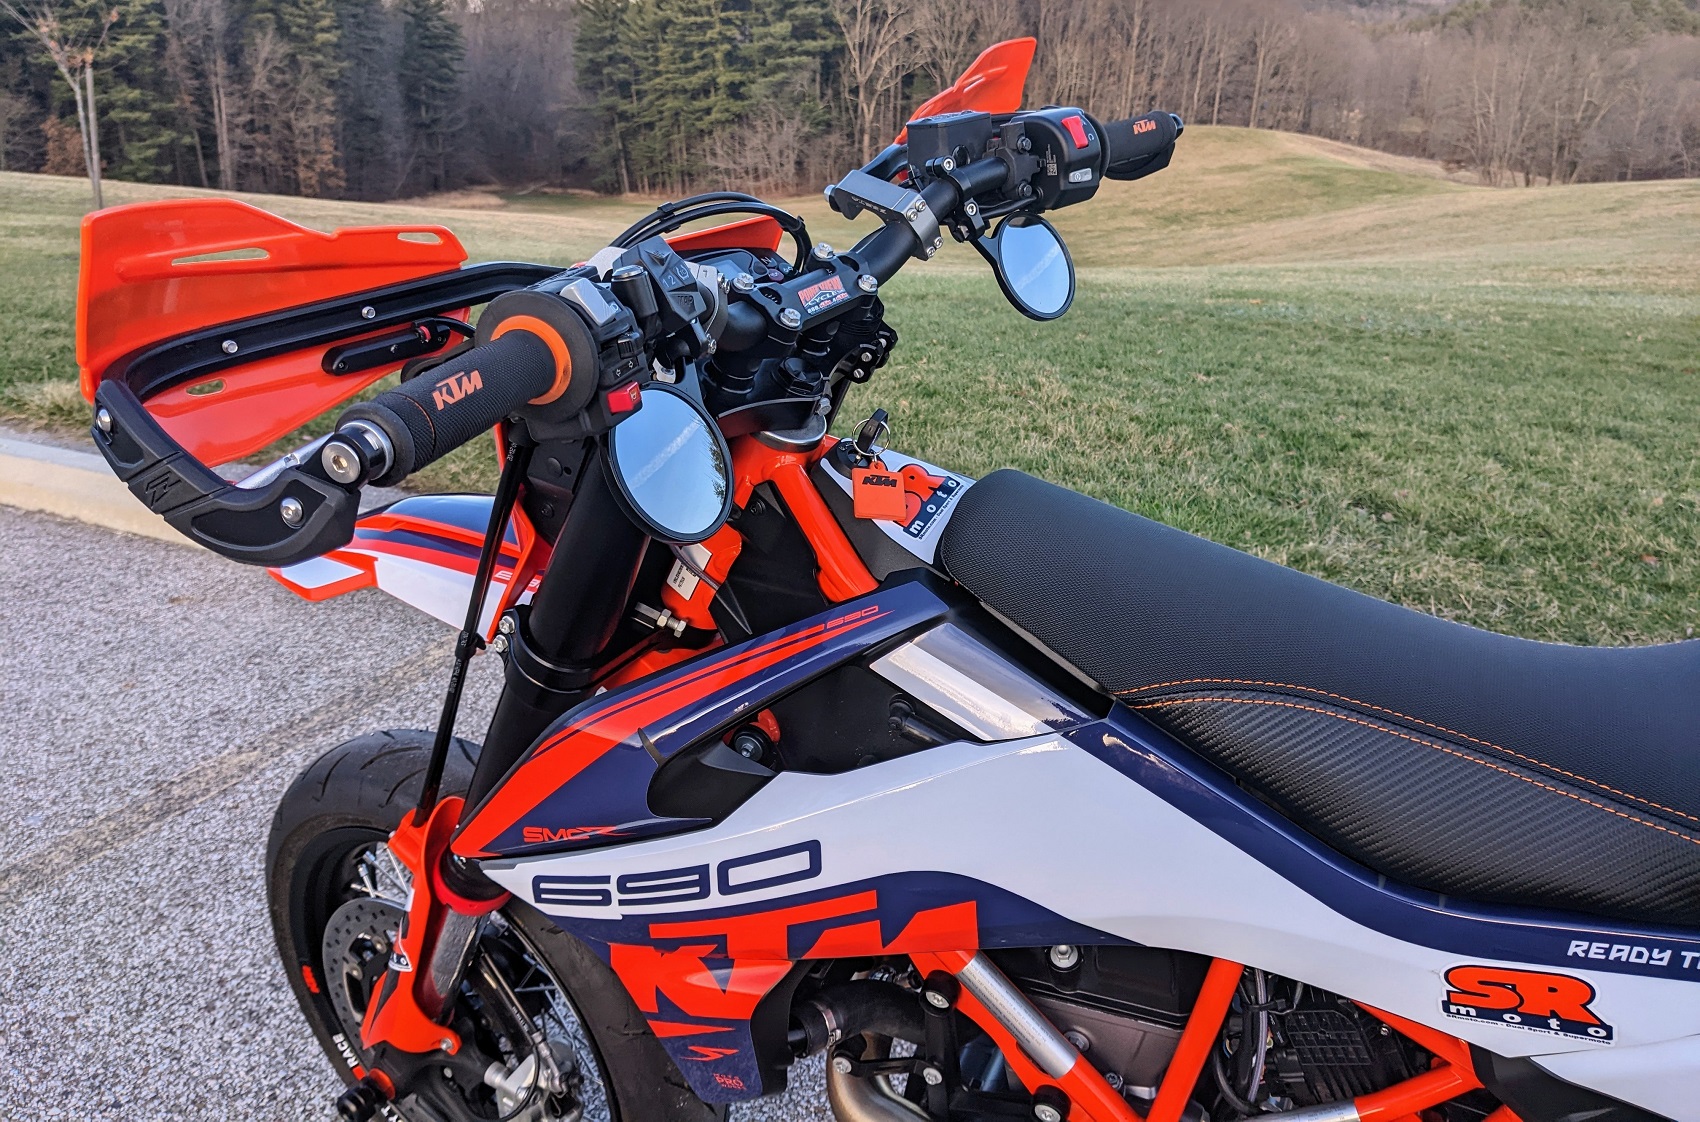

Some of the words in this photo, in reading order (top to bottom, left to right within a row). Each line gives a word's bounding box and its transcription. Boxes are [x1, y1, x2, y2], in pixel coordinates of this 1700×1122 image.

[1133, 119, 1157, 134] KTM
[432, 370, 483, 410] KTM
[862, 474, 898, 487] KTM
[909, 480, 957, 535] moto
[532, 839, 822, 907] 690
[610, 889, 979, 1020] KTM
[1567, 940, 1672, 966] READY
[1680, 951, 1700, 970] T
[1445, 965, 1601, 1025] SR
[1449, 1004, 1607, 1038] moto
[333, 1033, 359, 1068] RACE
